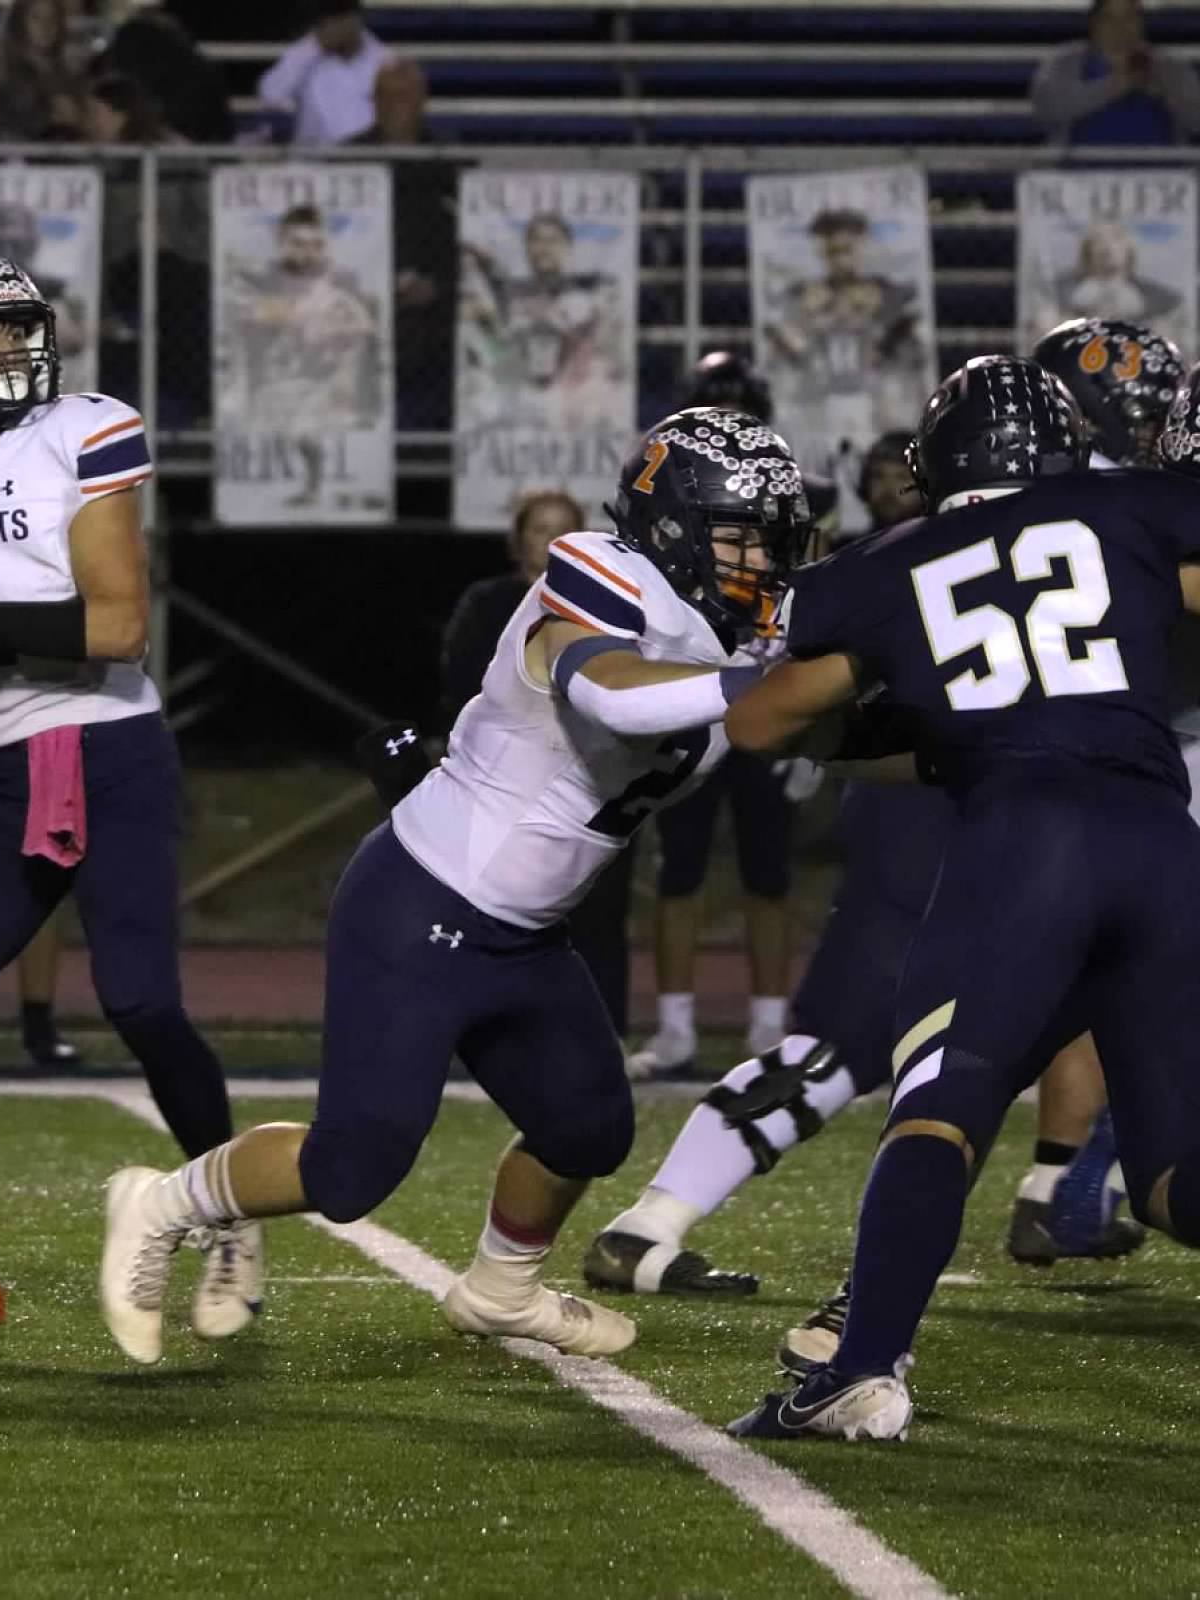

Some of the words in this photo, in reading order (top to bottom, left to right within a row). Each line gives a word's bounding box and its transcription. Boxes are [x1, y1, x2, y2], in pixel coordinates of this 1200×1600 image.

[1079, 337, 1142, 382] 63
[634, 442, 669, 494] 2
[910, 519, 1130, 711] 52
